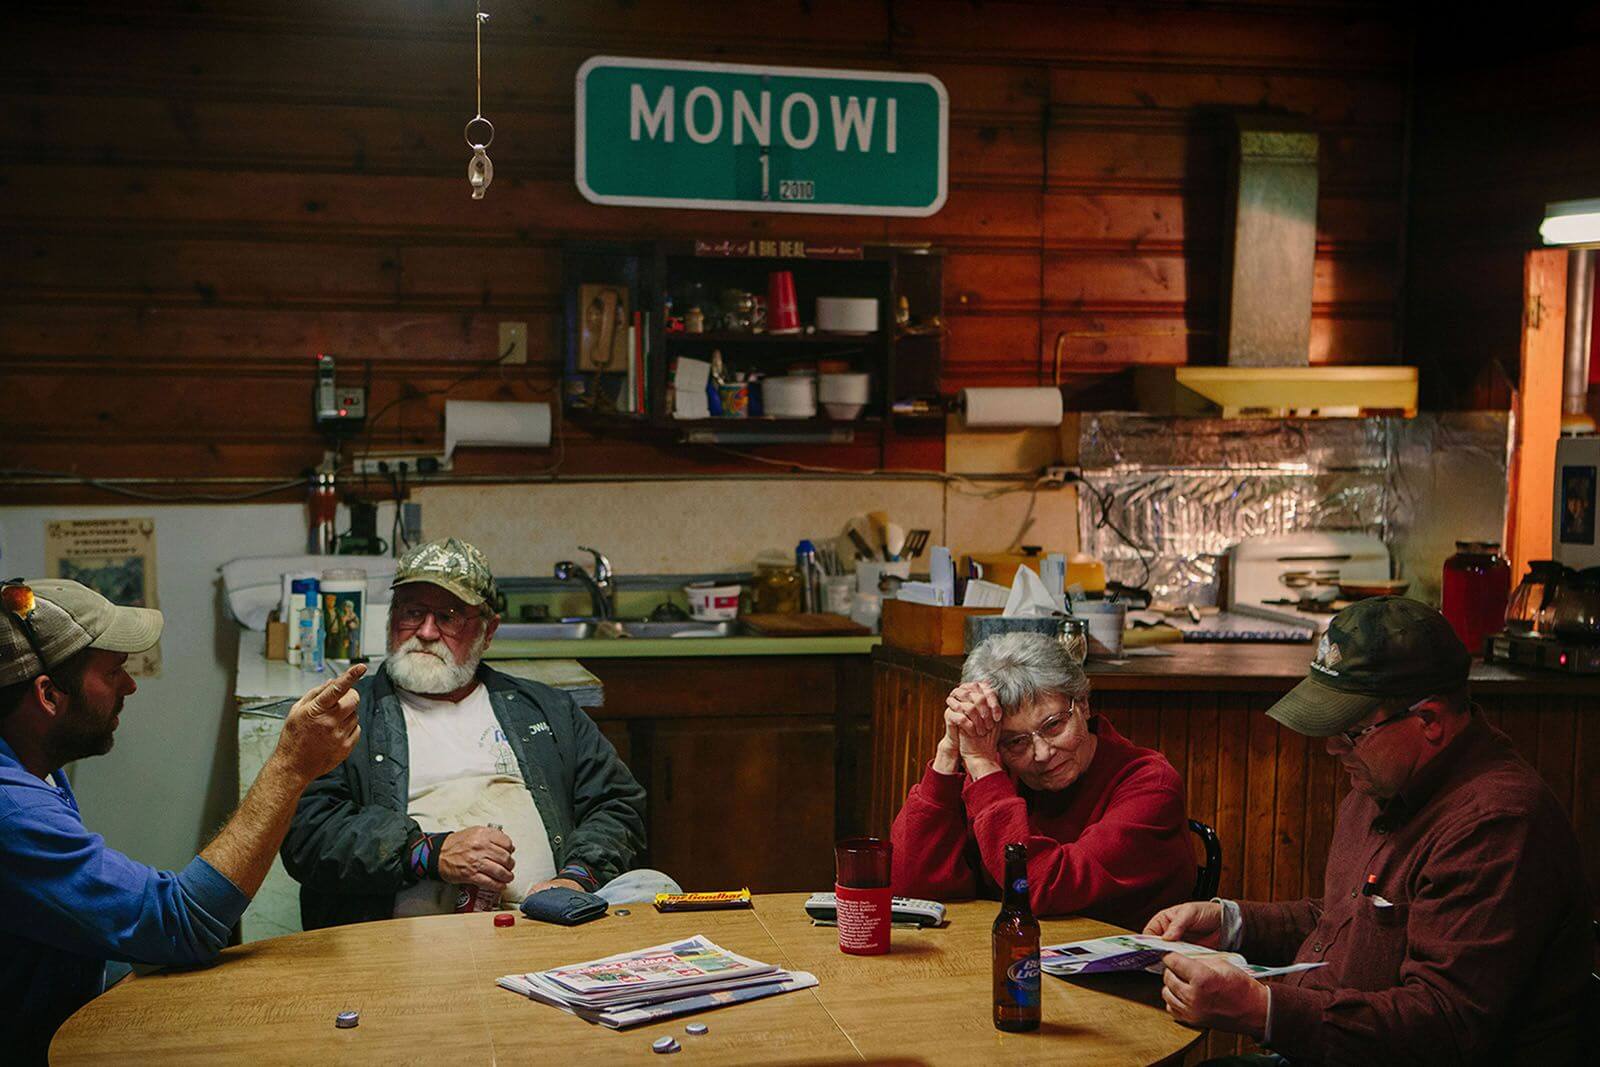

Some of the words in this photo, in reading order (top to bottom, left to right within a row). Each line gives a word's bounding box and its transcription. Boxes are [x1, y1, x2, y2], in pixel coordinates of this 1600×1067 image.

[629, 83, 898, 153] MONOWI
[759, 154, 770, 195] 1
[782, 182, 814, 198] 2010
[759, 240, 777, 257] BIG
[779, 240, 806, 258] DEAL
[1015, 968, 1040, 979] LIG
[1023, 960, 1040, 970] BU
